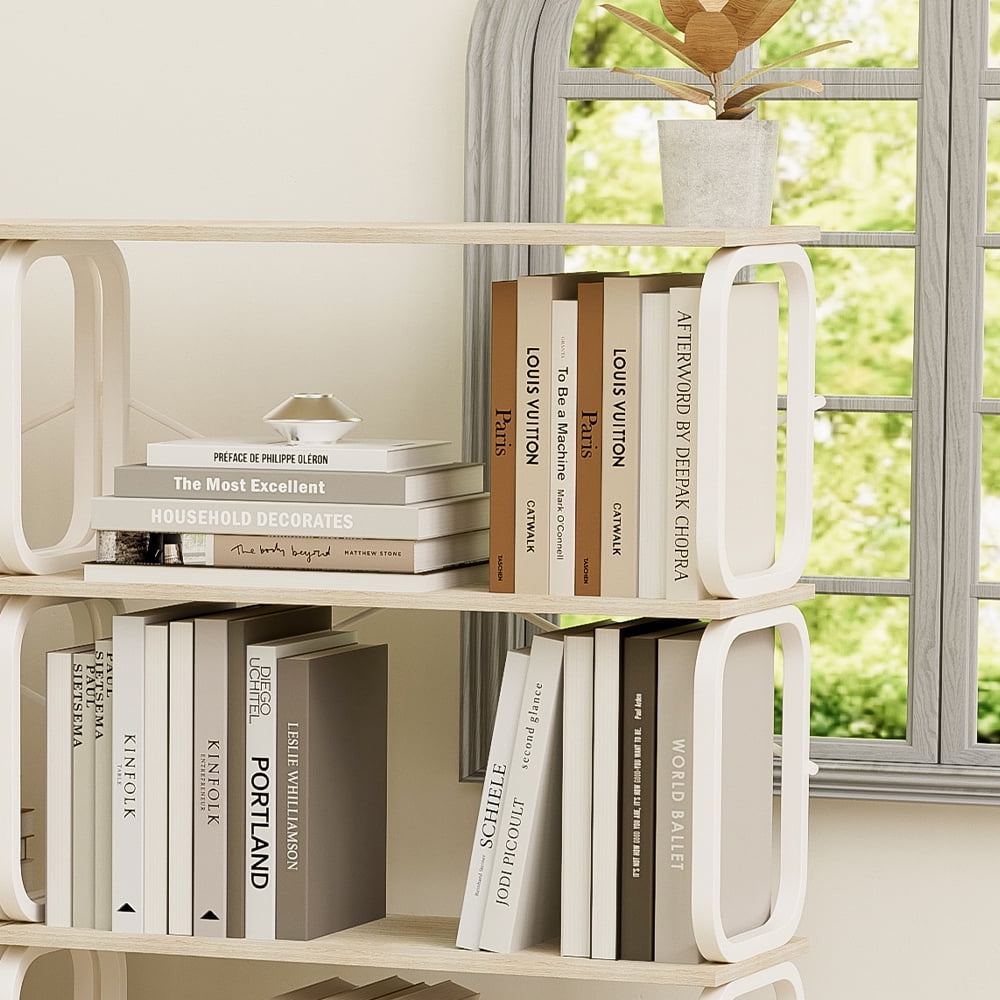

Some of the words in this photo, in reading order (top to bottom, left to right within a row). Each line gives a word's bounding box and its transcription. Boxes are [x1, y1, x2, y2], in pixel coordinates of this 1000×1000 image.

[527, 347, 540, 394] LOUIS
[613, 349, 626, 396] LOUIS
[676, 310, 692, 415] AFTERWORD
[214, 450, 247, 464] PRÉFACE
[249, 453, 259, 464] DE
[262, 453, 296, 464] PHILIPPE
[298, 451, 328, 465] OLÉRON
[495, 408, 512, 456] Paris
[526, 399, 540, 465] VUITTON
[581, 410, 598, 458] Paris
[612, 401, 626, 467] VUITTON
[676, 421, 691, 442] BY
[174, 477, 201, 491] The
[206, 478, 246, 492] Most
[251, 479, 325, 494] Excellent
[675, 448, 690, 509] DEEPAK
[152, 508, 251, 526] HOUSEHOLD
[257, 510, 353, 529] DECORATES
[526, 500, 535, 553] CATWALK
[674, 516, 689, 582] CHOPRA
[231, 544, 256, 556] The
[260, 542, 285, 557] body
[291, 544, 332, 562] beyond
[72, 663, 83, 747] SIETSEMA
[94, 651, 104, 740] SIETSEMA
[250, 658, 260, 724] UCHITEL
[260, 666, 271, 716] DIEGO
[288, 722, 298, 766] LESLIE
[521, 726, 535, 769] second
[528, 682, 543, 723] glance
[124, 734, 136, 819] KINFOLK
[207, 740, 220, 825] KINFOLK
[672, 738, 685, 801] WORLD
[251, 757, 269, 889] PORTLAND
[287, 770, 298, 870] WHILLIAMSON
[479, 764, 507, 848] SCHIELE
[496, 865, 512, 907] JODI
[504, 797, 525, 865] PICOULT
[671, 810, 685, 870] BALLET
